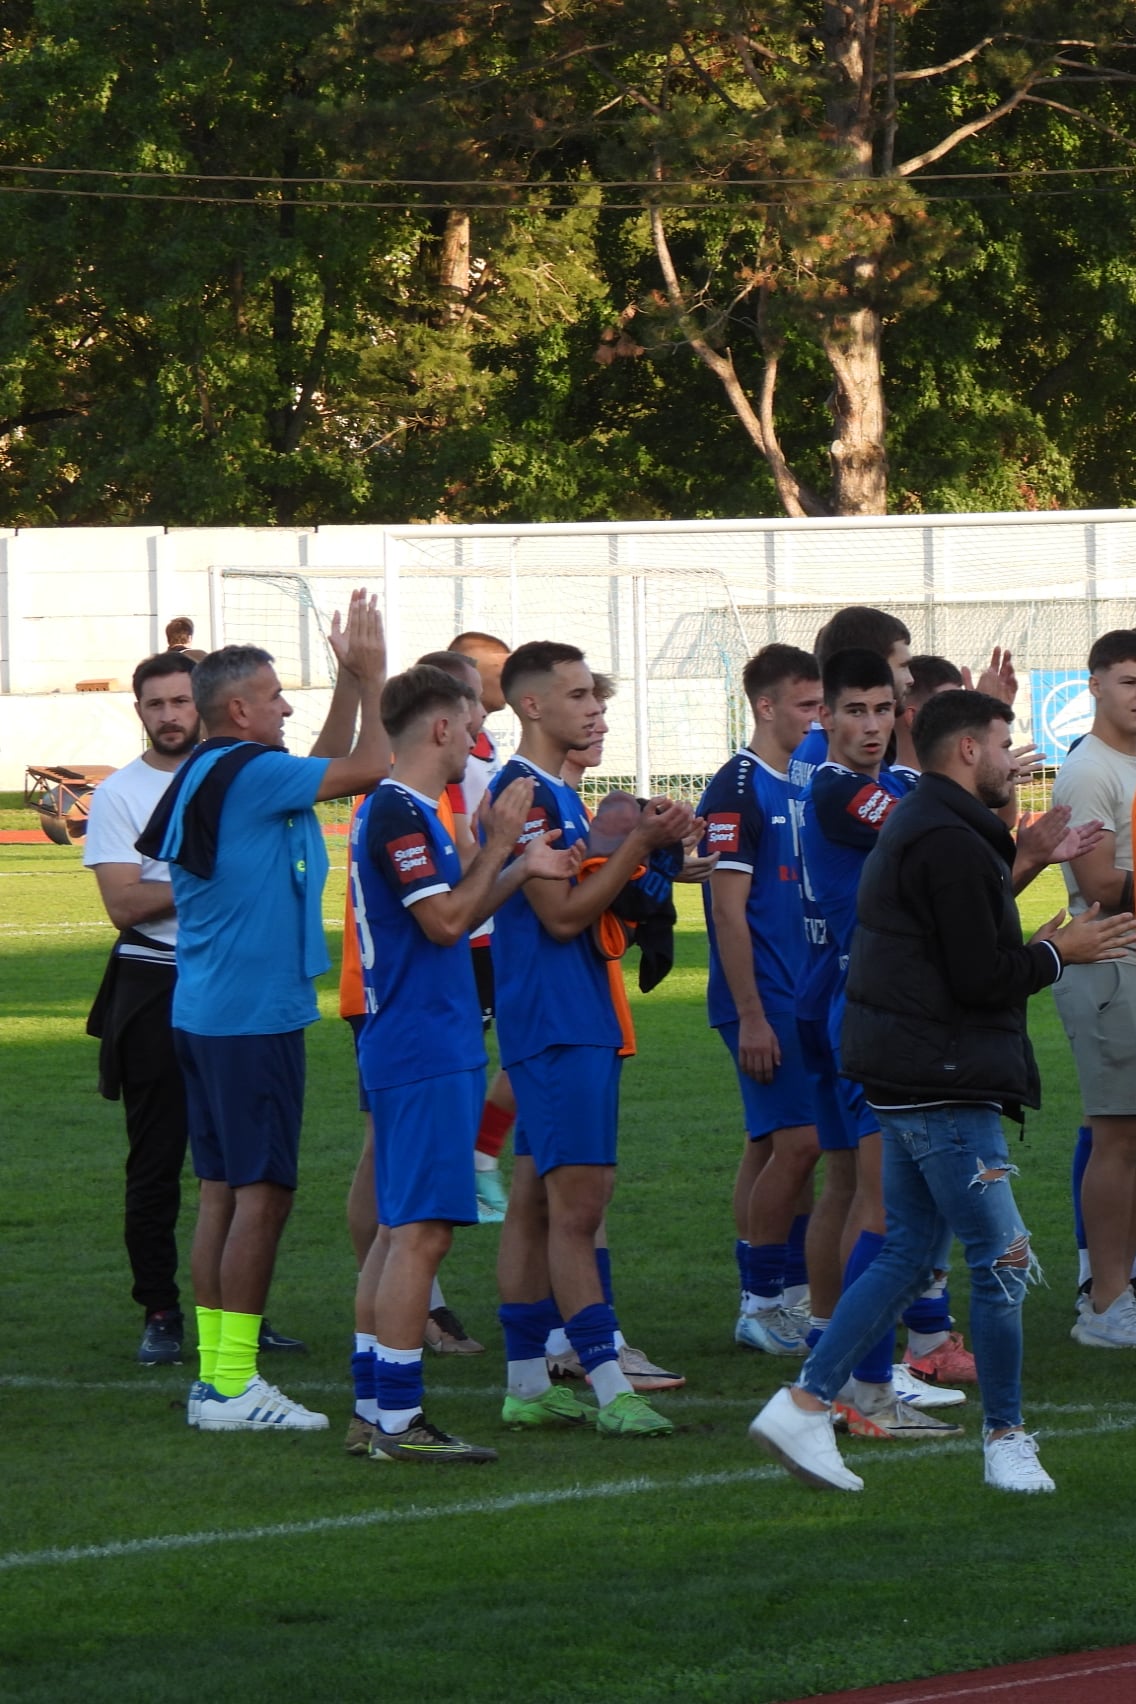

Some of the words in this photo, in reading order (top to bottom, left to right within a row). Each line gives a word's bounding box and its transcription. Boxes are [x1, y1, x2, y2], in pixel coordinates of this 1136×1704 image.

[707, 822, 738, 833] Super
[708, 832, 736, 844] Sport
[394, 844, 427, 862] Super
[399, 855, 428, 872] Sport
